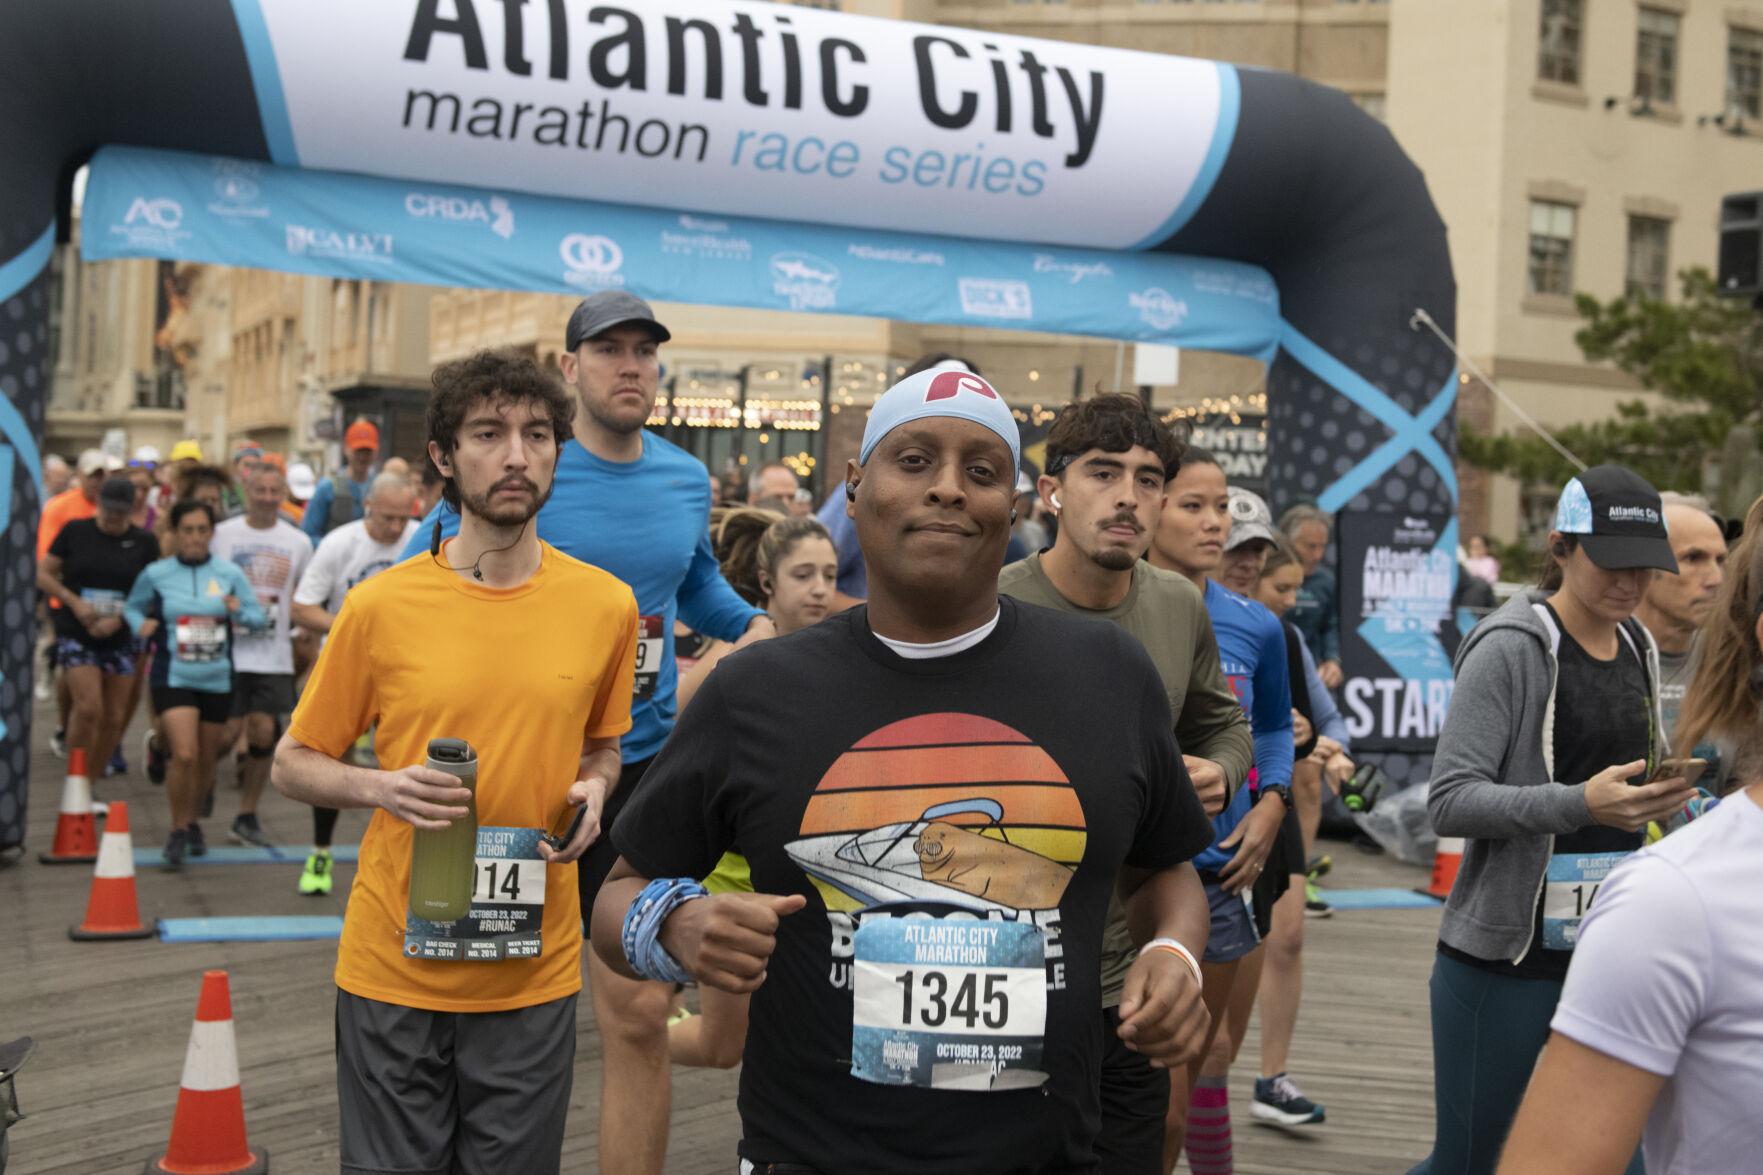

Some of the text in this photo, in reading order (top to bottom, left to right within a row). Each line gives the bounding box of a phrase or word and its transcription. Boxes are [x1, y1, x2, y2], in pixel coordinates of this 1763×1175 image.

[402, 0, 1105, 168] Atlantic City
[402, 87, 1048, 197] marathon race series
[405, 193, 490, 223] CRDA
[1609, 505, 1645, 517] Atlantic
[1344, 676, 1455, 738] STAR
[495, 832, 515, 845] CITY
[475, 844, 507, 857] ATHON
[472, 862, 520, 900] 14
[469, 909, 498, 919] OCTOBER
[510, 910, 528, 920] 2022
[479, 920, 516, 932] #RUNAC
[904, 925, 999, 946] ATLANTIC CITY
[437, 949, 454, 957] 2014
[915, 944, 988, 964] MARATHON
[895, 969, 1009, 1030] 1345
[936, 1043, 1022, 1060] OCTOBER 23, 2022
